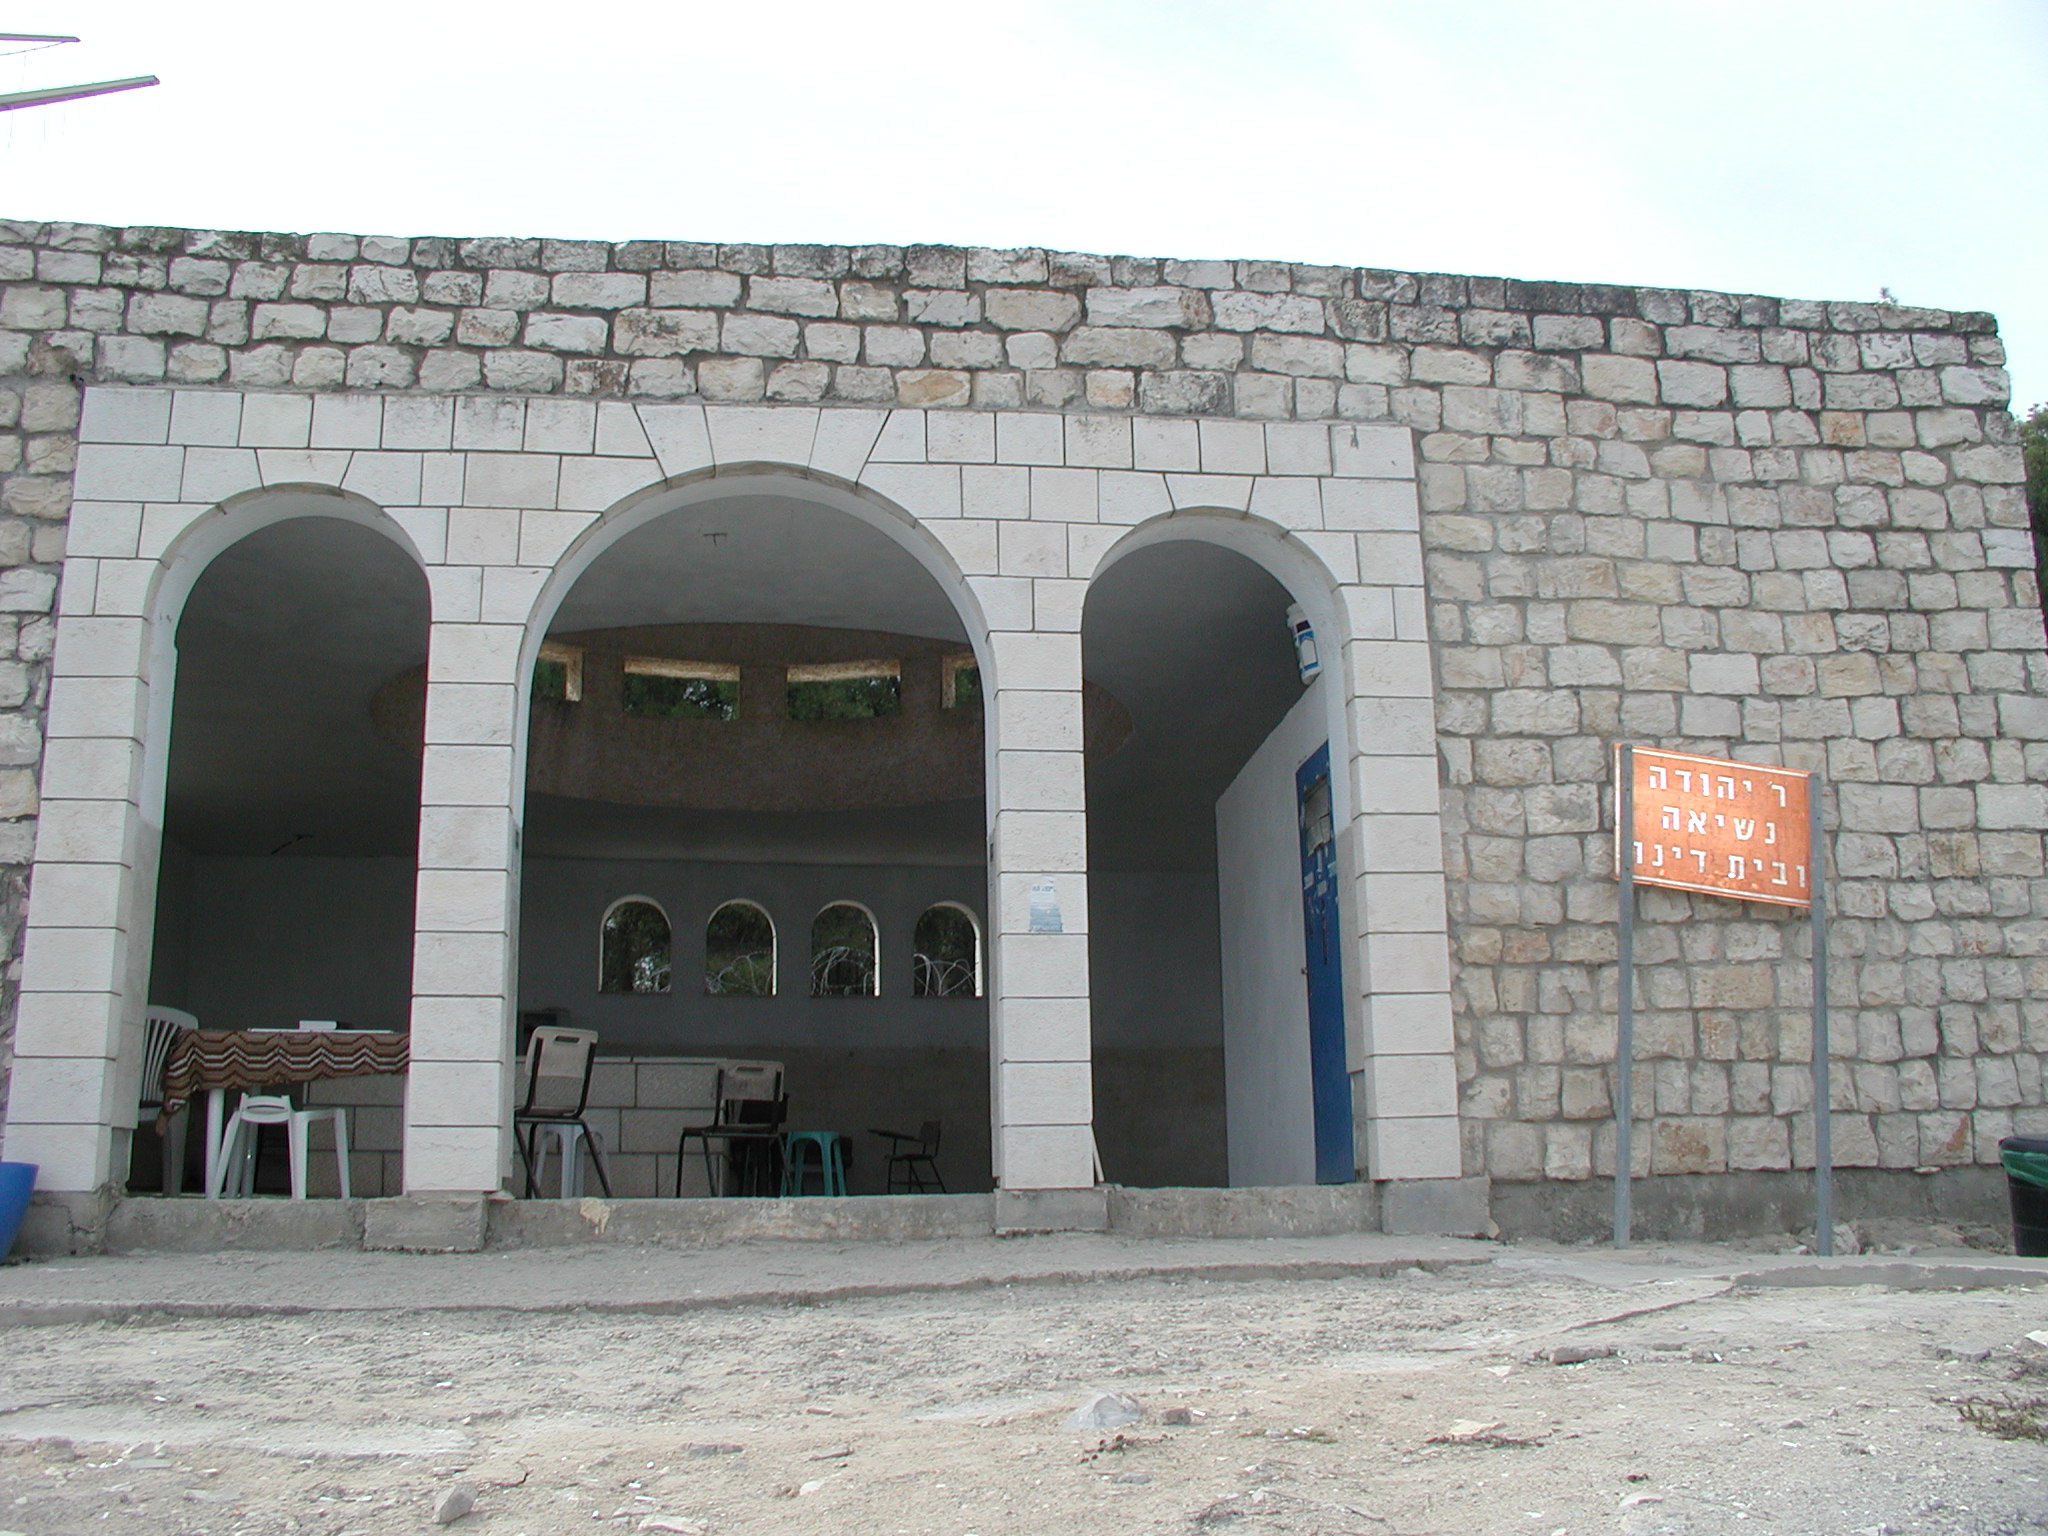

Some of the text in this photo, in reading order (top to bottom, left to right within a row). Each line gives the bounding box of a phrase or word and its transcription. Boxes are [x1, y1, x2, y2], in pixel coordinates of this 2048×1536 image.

[1649, 765, 1752, 799] יהודה
[1661, 805, 1776, 844] נשיאה
[1633, 841, 1806, 888] ובית דינו
